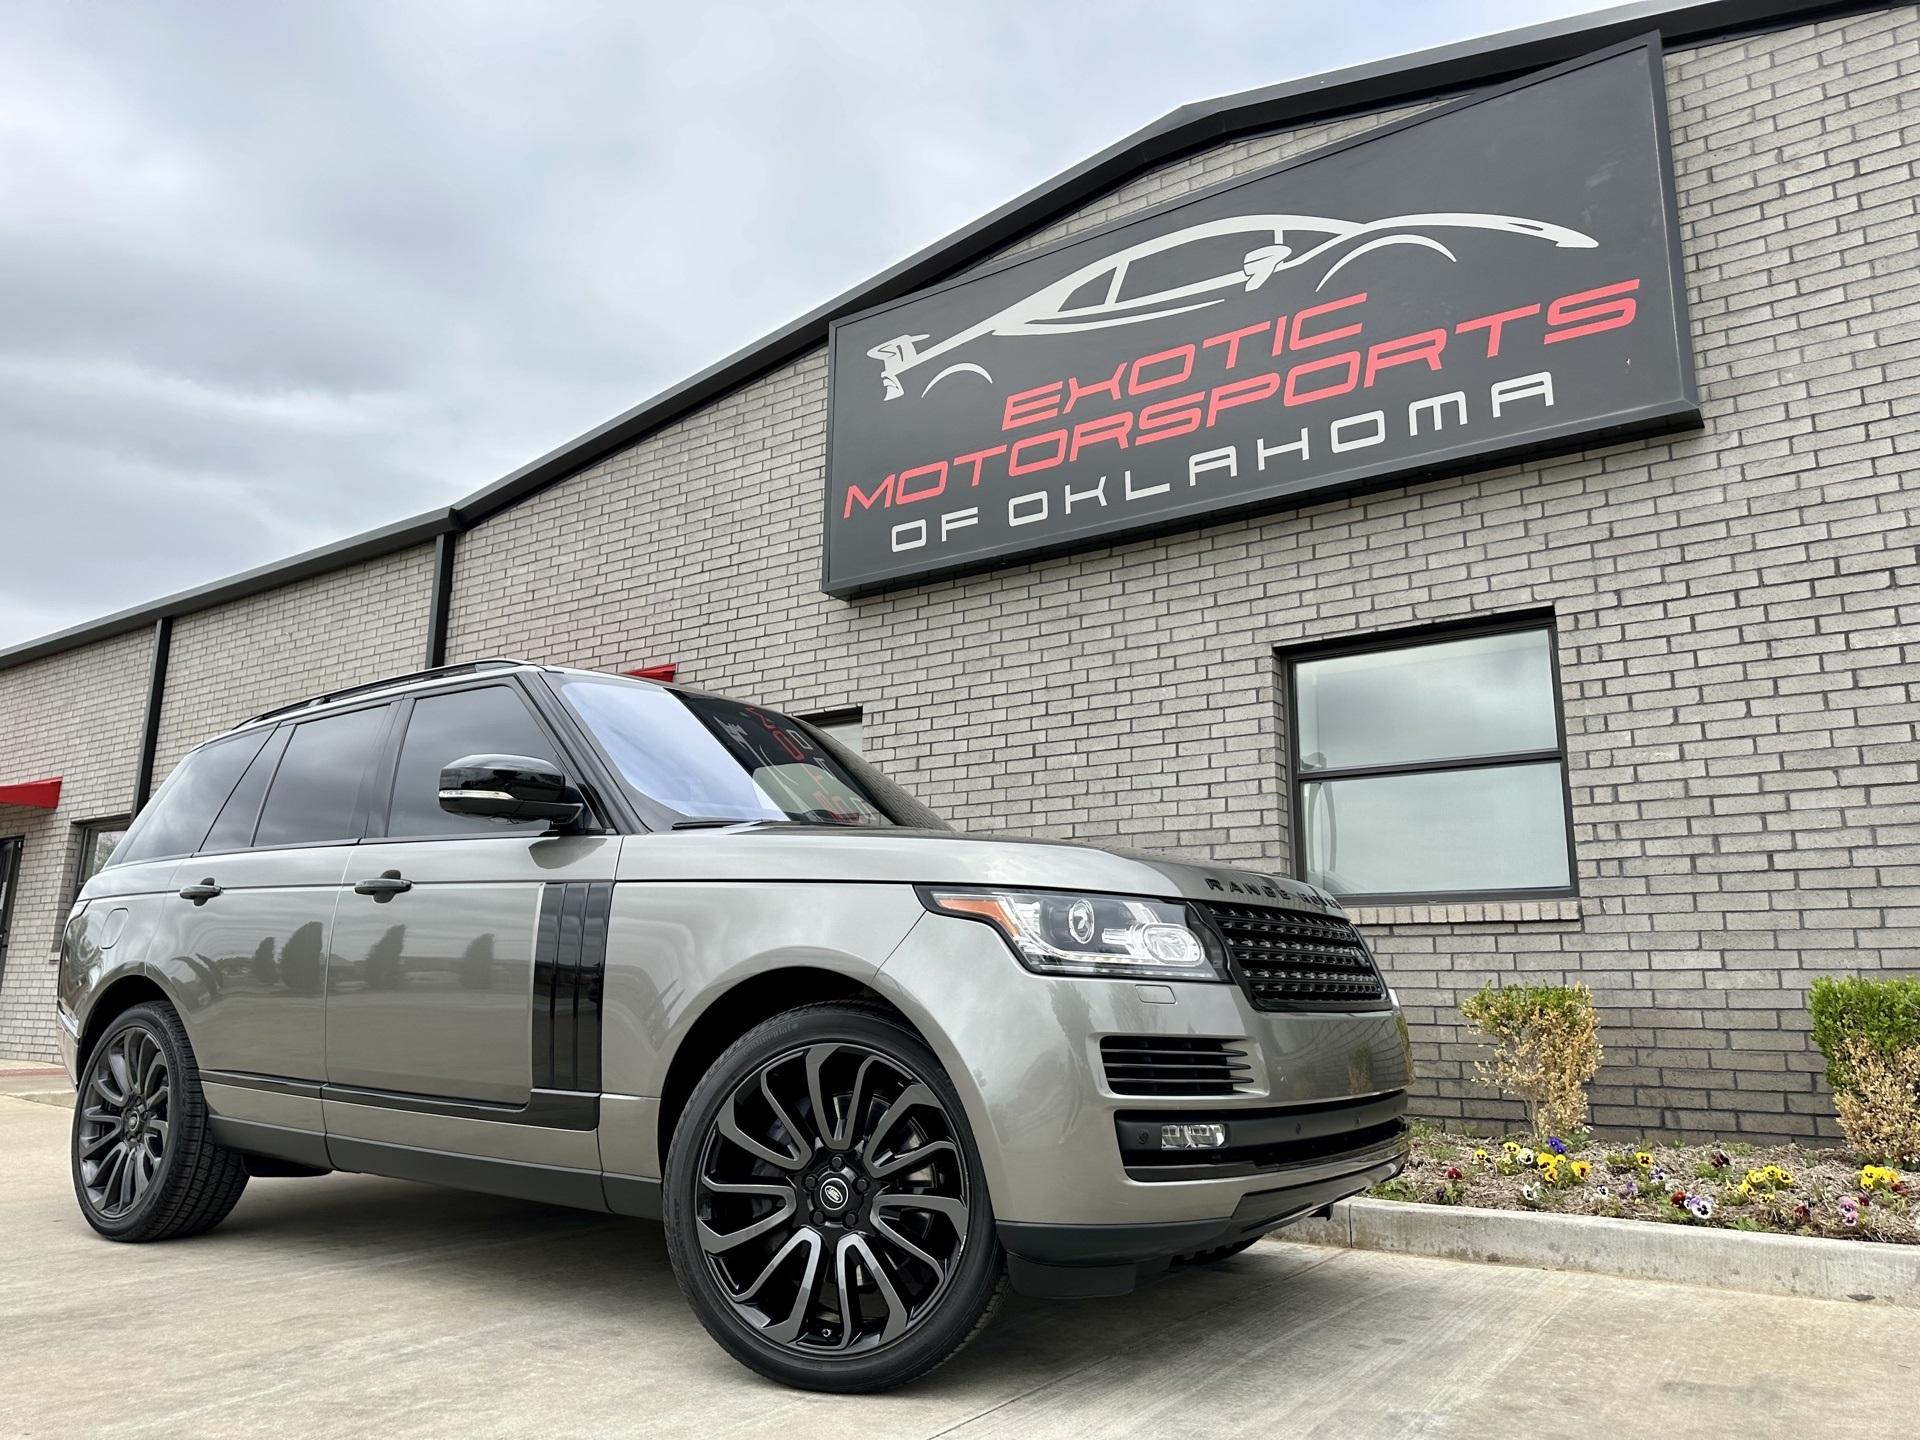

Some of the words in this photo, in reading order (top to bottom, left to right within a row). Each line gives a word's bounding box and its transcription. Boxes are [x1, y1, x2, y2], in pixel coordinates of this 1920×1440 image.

[843, 279, 1641, 519] MOTORSPORTS
[1002, 292, 1368, 431] EXOTIC
[891, 506, 979, 553] OF
[1008, 371, 1555, 527] OKLAHOMA
[1204, 878, 1291, 900] RANGE
